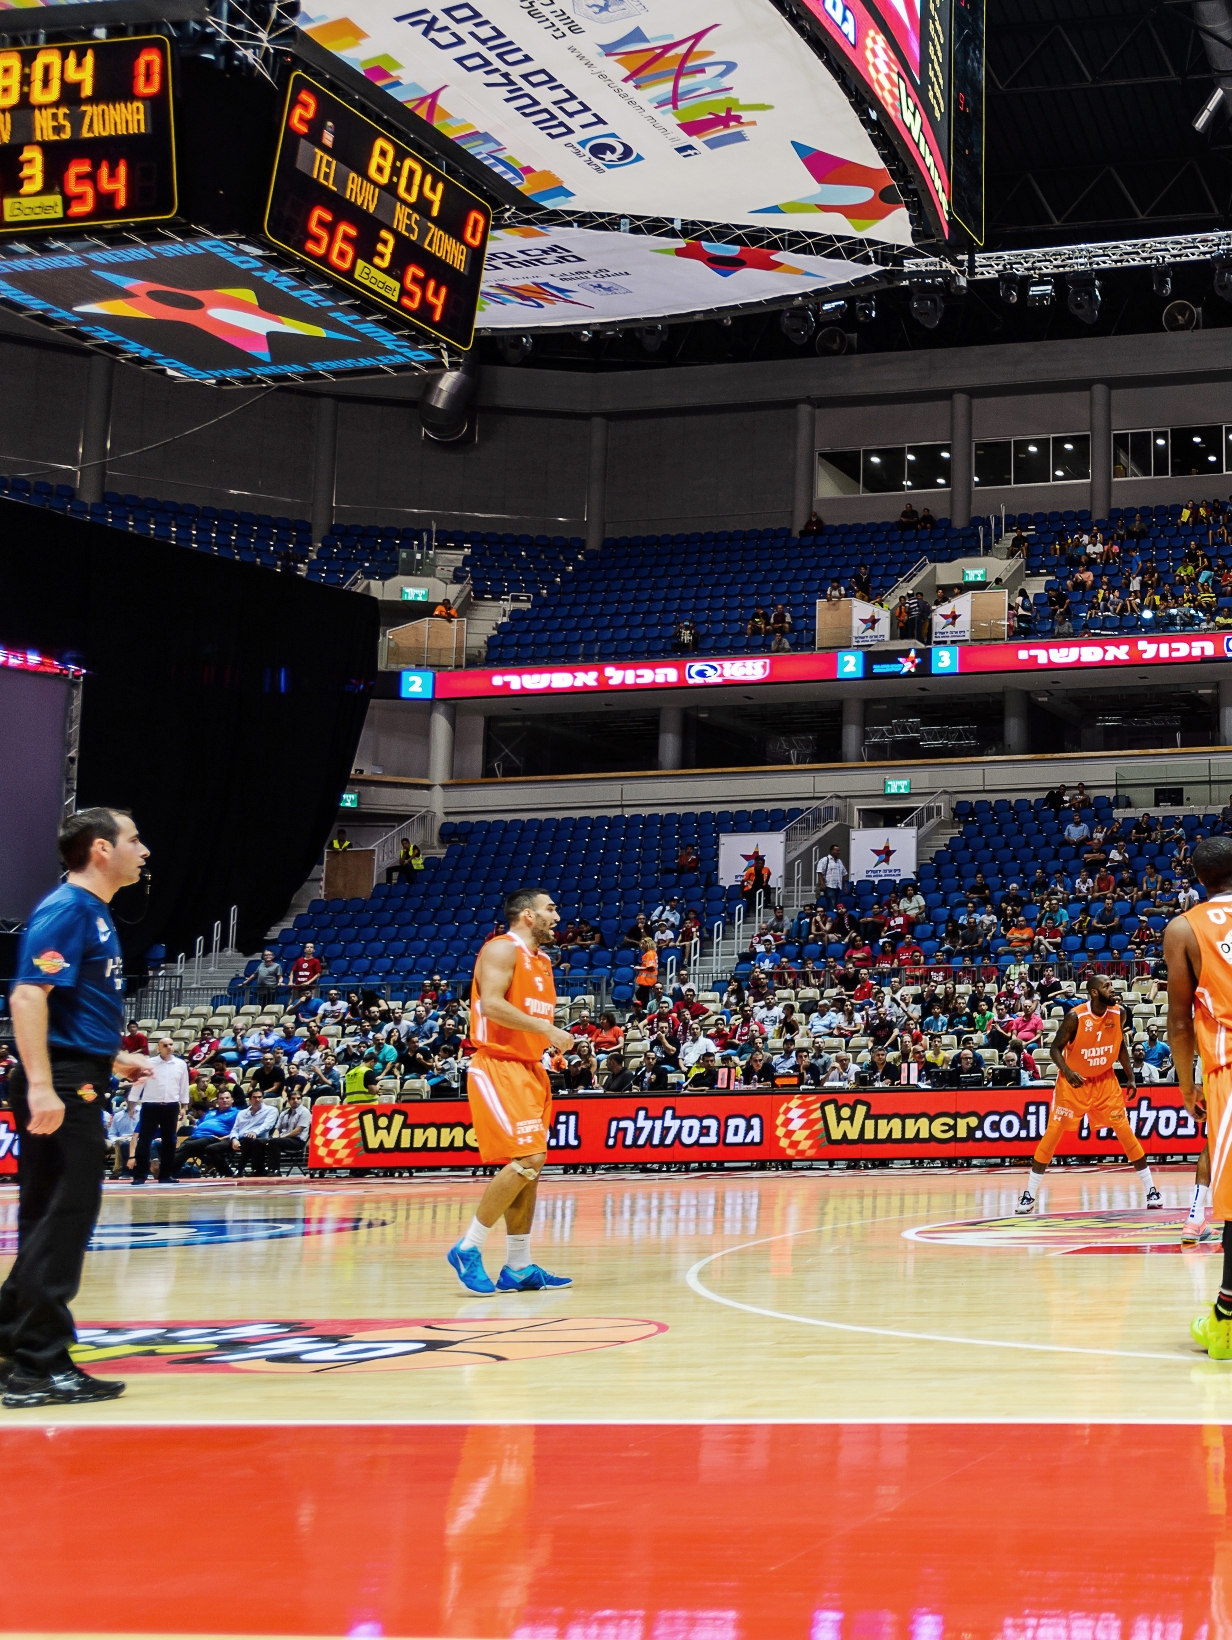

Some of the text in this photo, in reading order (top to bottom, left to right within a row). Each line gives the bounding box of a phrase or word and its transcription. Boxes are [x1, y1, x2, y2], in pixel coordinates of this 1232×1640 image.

[133, 47, 162, 97] 0
[393, 8, 576, 140] מתחילים כאן
[440, 2, 609, 130] דברים טובים
[34, 105, 71, 141] NES
[79, 101, 146, 139] ZIONNA
[289, 89, 317, 134] 2
[18, 145, 44, 195] 3
[64, 158, 128, 217] 54
[367, 136, 444, 217] 8:04
[312, 148, 467, 272] TEL AVIV NES ZIONNA
[464, 210, 485, 248] 0
[305, 205, 358, 271] 56
[372, 229, 395, 268] 3
[358, 265, 398, 298] Bodet
[400, 263, 447, 321] 54
[843, 655, 856, 672] 2
[938, 650, 951, 667] 3
[1018, 639, 1214, 664] הכול אפשרי
[408, 675, 423, 692] 2
[492, 667, 678, 691] הכול אפשרי
[725, 1117, 761, 1144] גם
[824, 1103, 1048, 1140] Winner.co.il
